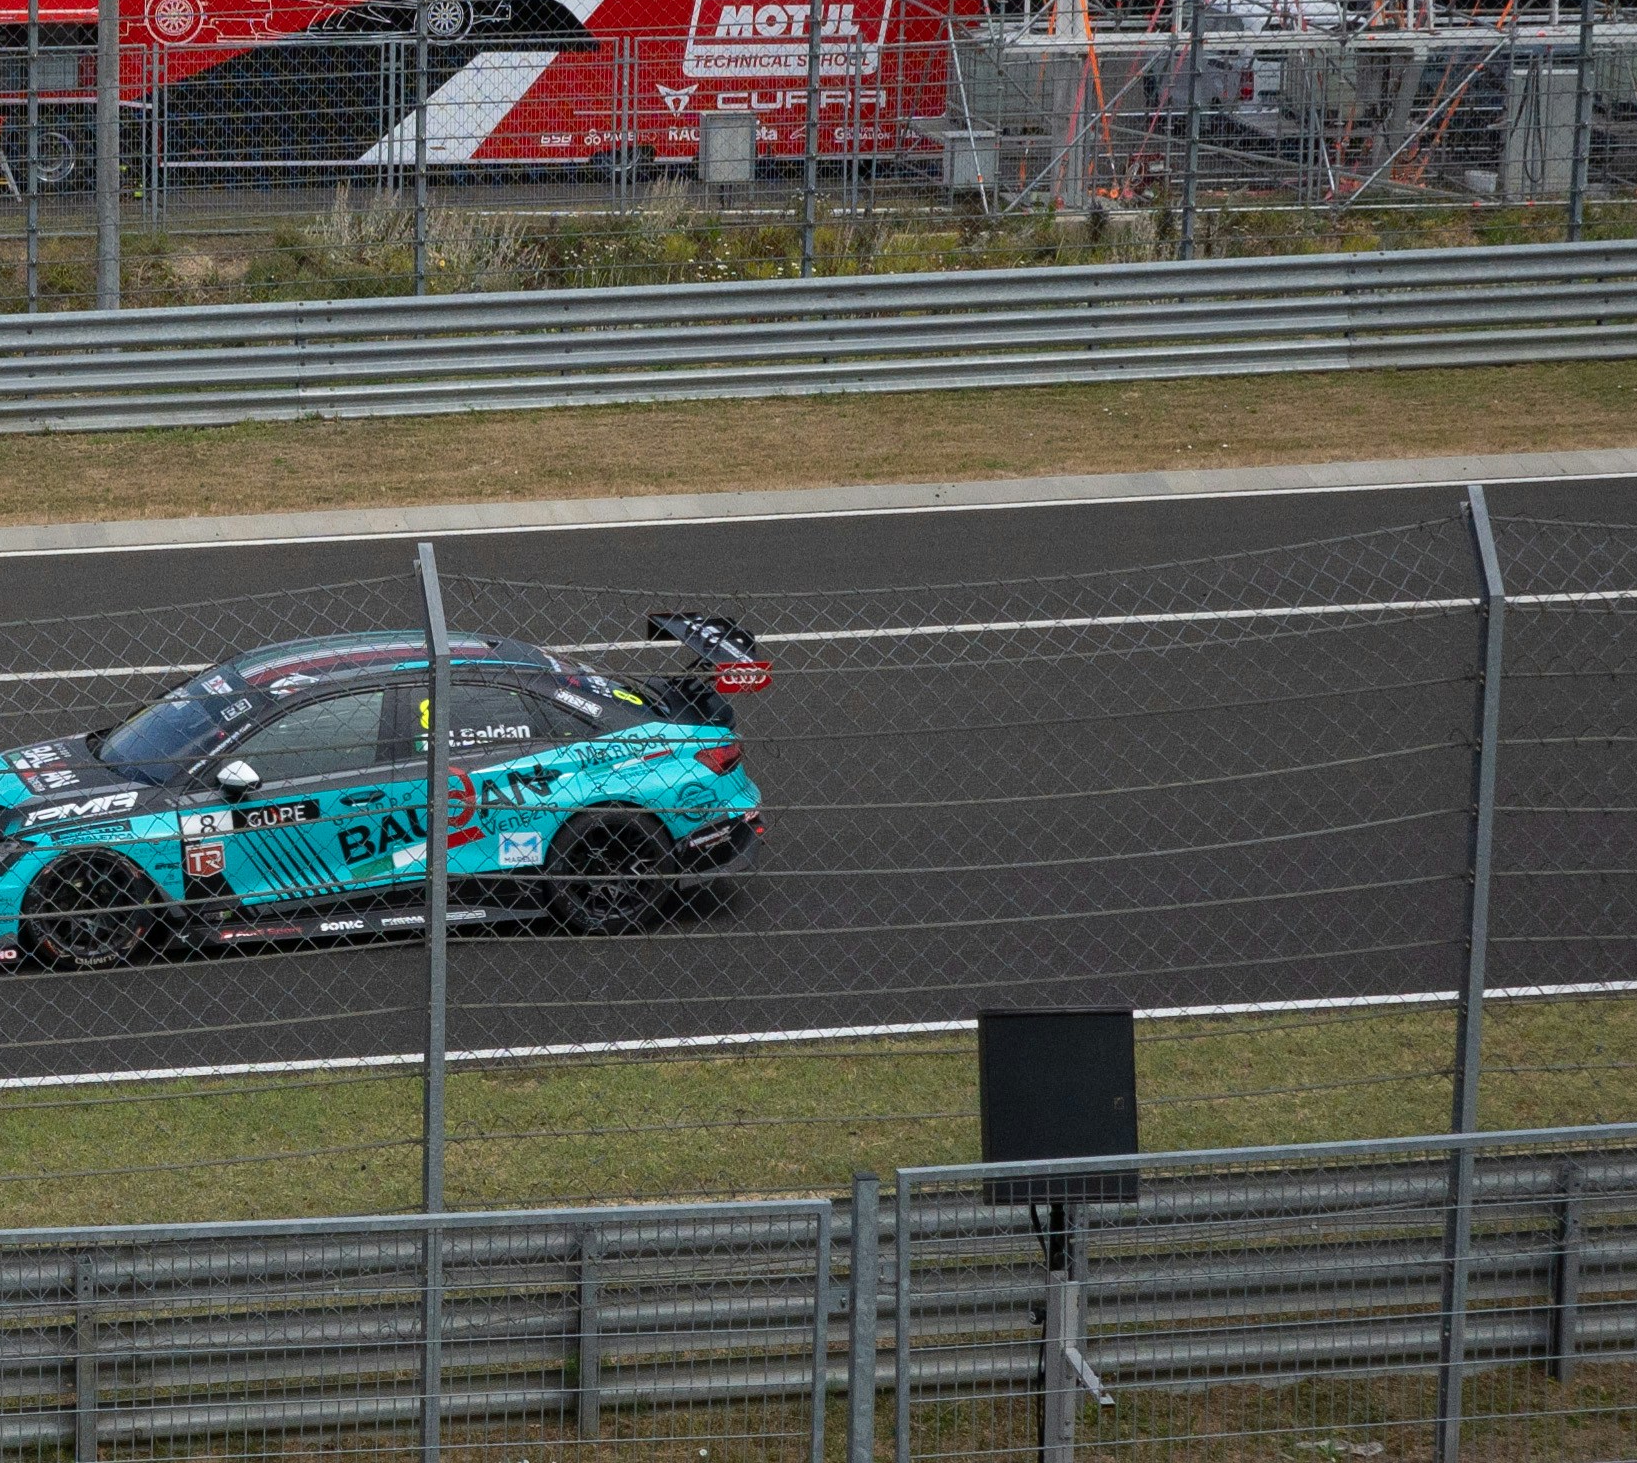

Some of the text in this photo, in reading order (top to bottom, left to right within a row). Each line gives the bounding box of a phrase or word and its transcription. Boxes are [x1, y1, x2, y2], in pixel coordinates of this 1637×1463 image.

[715, 4, 860, 37] MOTUL
[694, 52, 871, 68] TECHNICAL SHOOL
[199, 815, 216, 835] 8
[189, 851, 222, 872] TR
